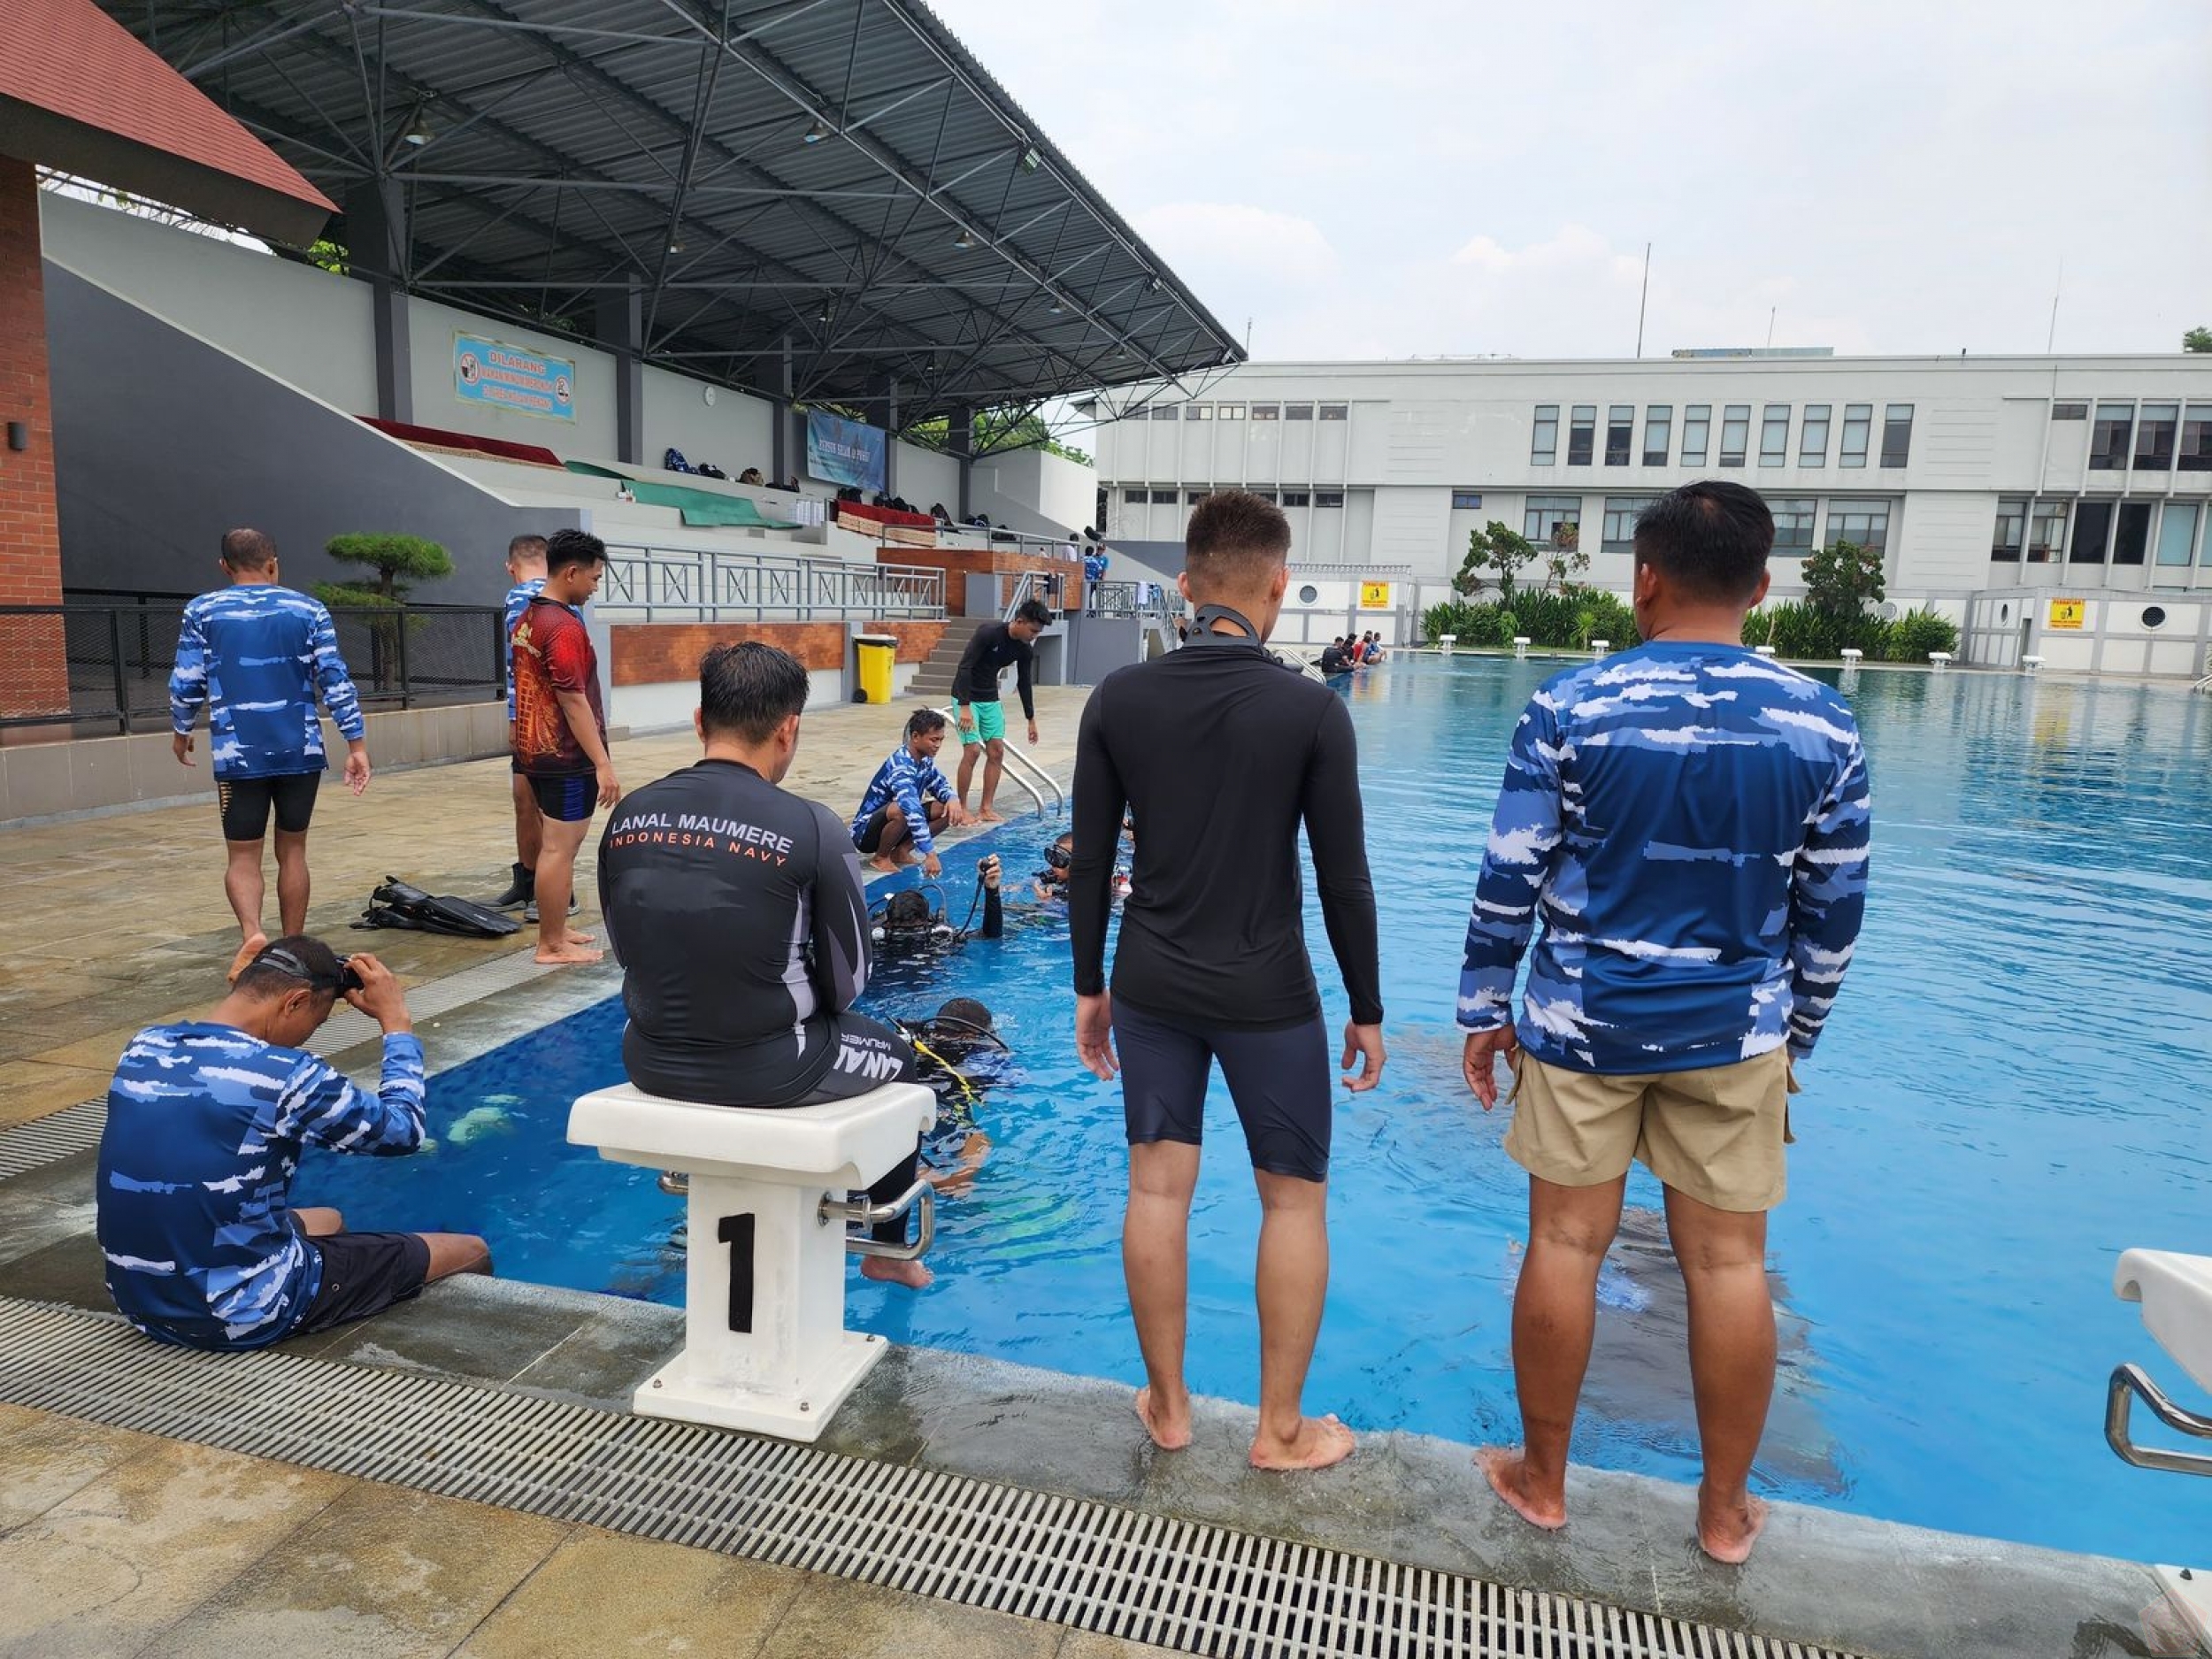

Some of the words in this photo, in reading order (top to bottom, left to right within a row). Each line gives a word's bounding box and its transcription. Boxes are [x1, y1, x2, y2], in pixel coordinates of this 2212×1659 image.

[489, 350, 546, 373] DILARANG
[610, 832, 715, 849] INDONESIA
[728, 841, 787, 866] NAVY
[611, 812, 672, 834] LANAL
[678, 813, 794, 854] MAUMERE
[718, 1212, 756, 1334] 1
